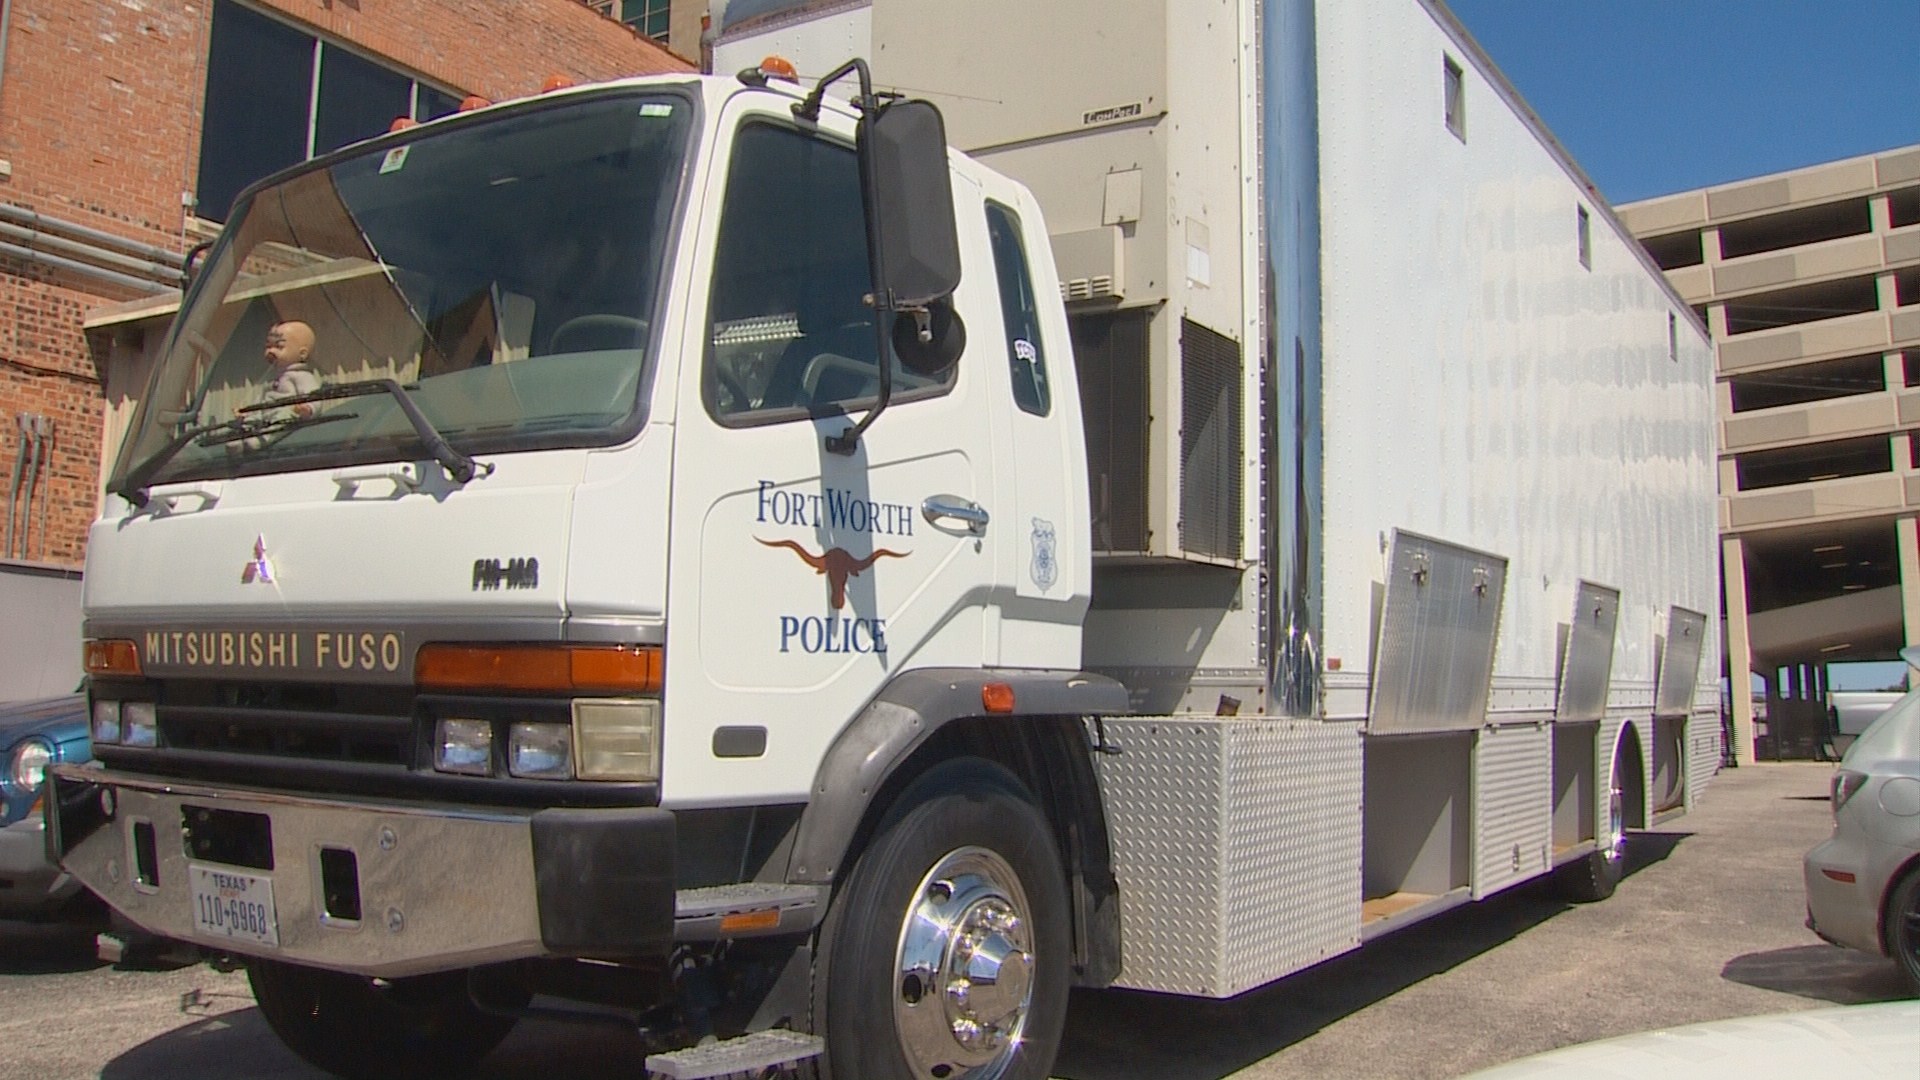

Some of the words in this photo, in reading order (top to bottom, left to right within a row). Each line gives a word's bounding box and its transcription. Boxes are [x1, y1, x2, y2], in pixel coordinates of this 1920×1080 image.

[146, 632, 298, 667] MITSUBISHI
[316, 633, 400, 671] FUSO
[780, 616, 887, 653] POLICE
[213, 875, 246, 891] TEXAS
